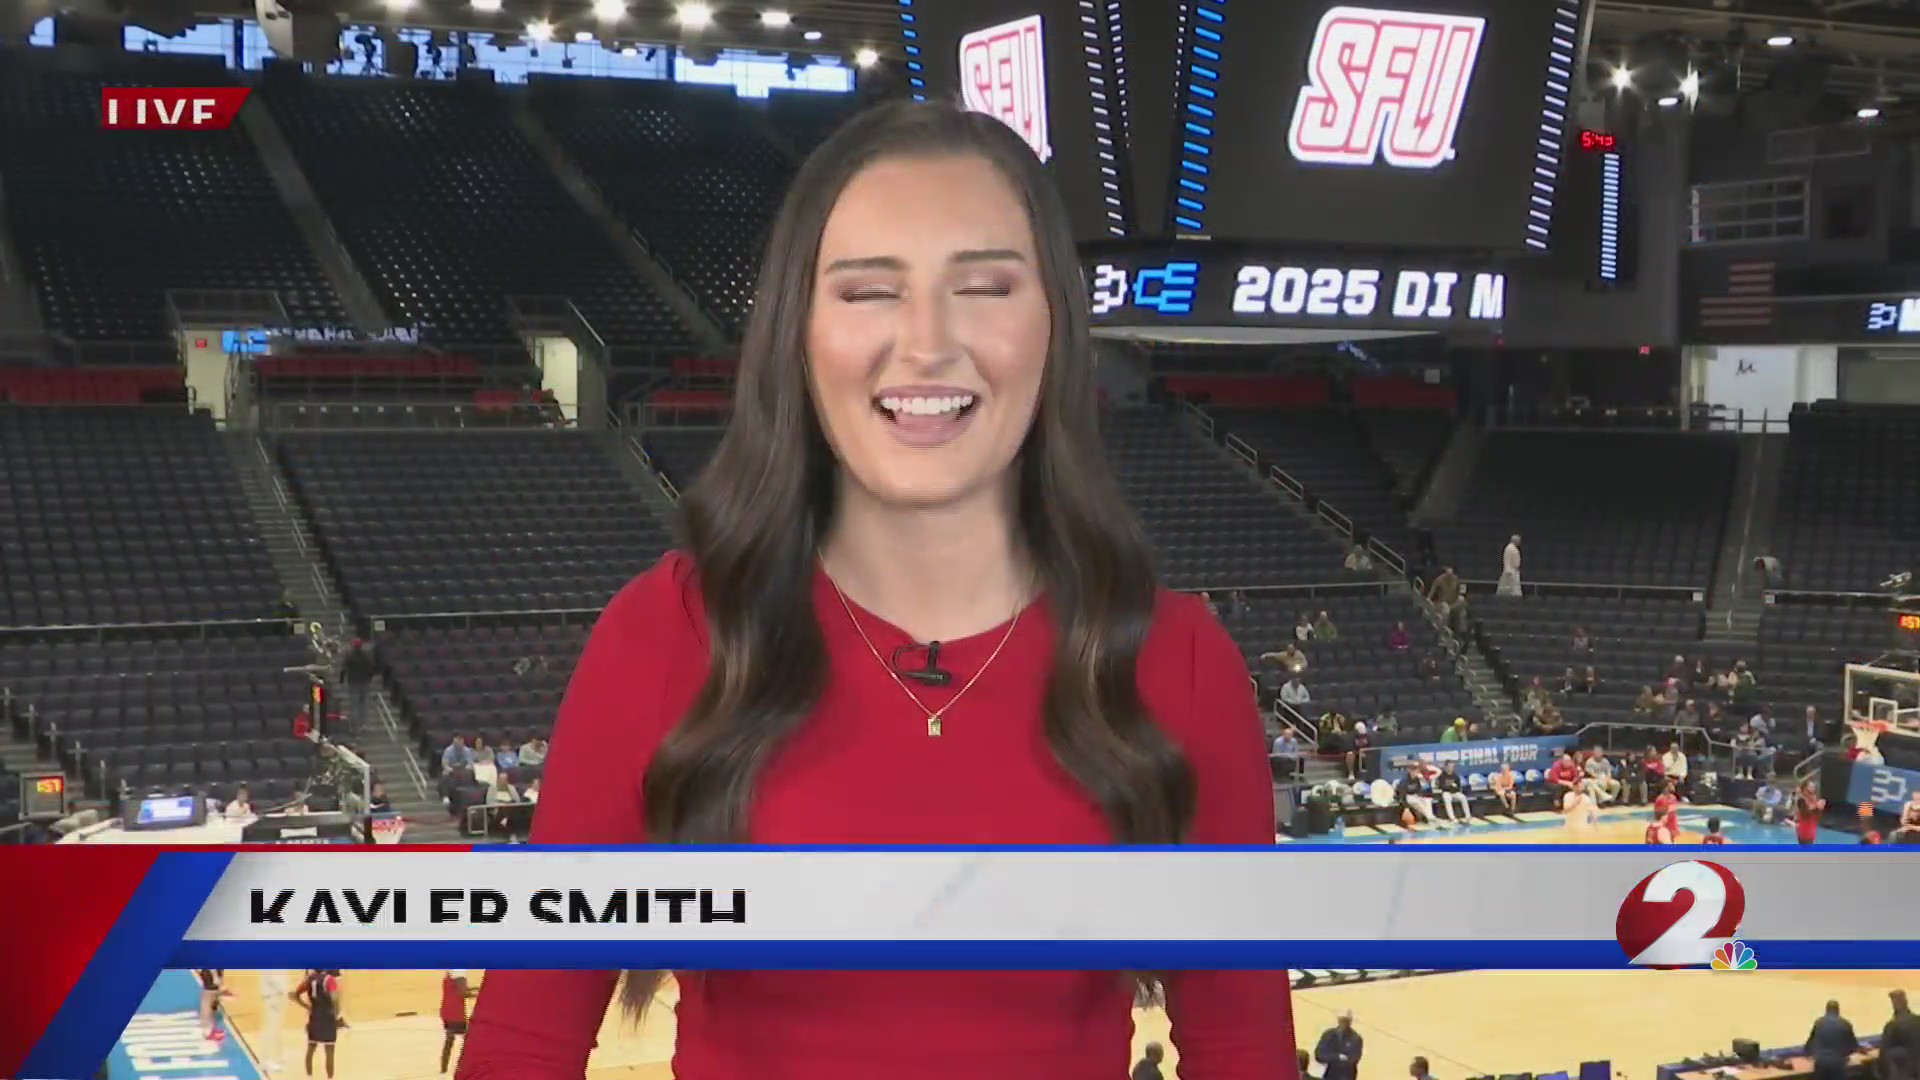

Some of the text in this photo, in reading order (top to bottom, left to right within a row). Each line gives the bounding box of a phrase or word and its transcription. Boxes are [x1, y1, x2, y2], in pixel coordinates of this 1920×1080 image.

[1288, 6, 1486, 168] SFU
[1233, 265, 1380, 315] 2025
[1392, 271, 1459, 317] DI
[1503, 744, 1539, 762] FOUR
